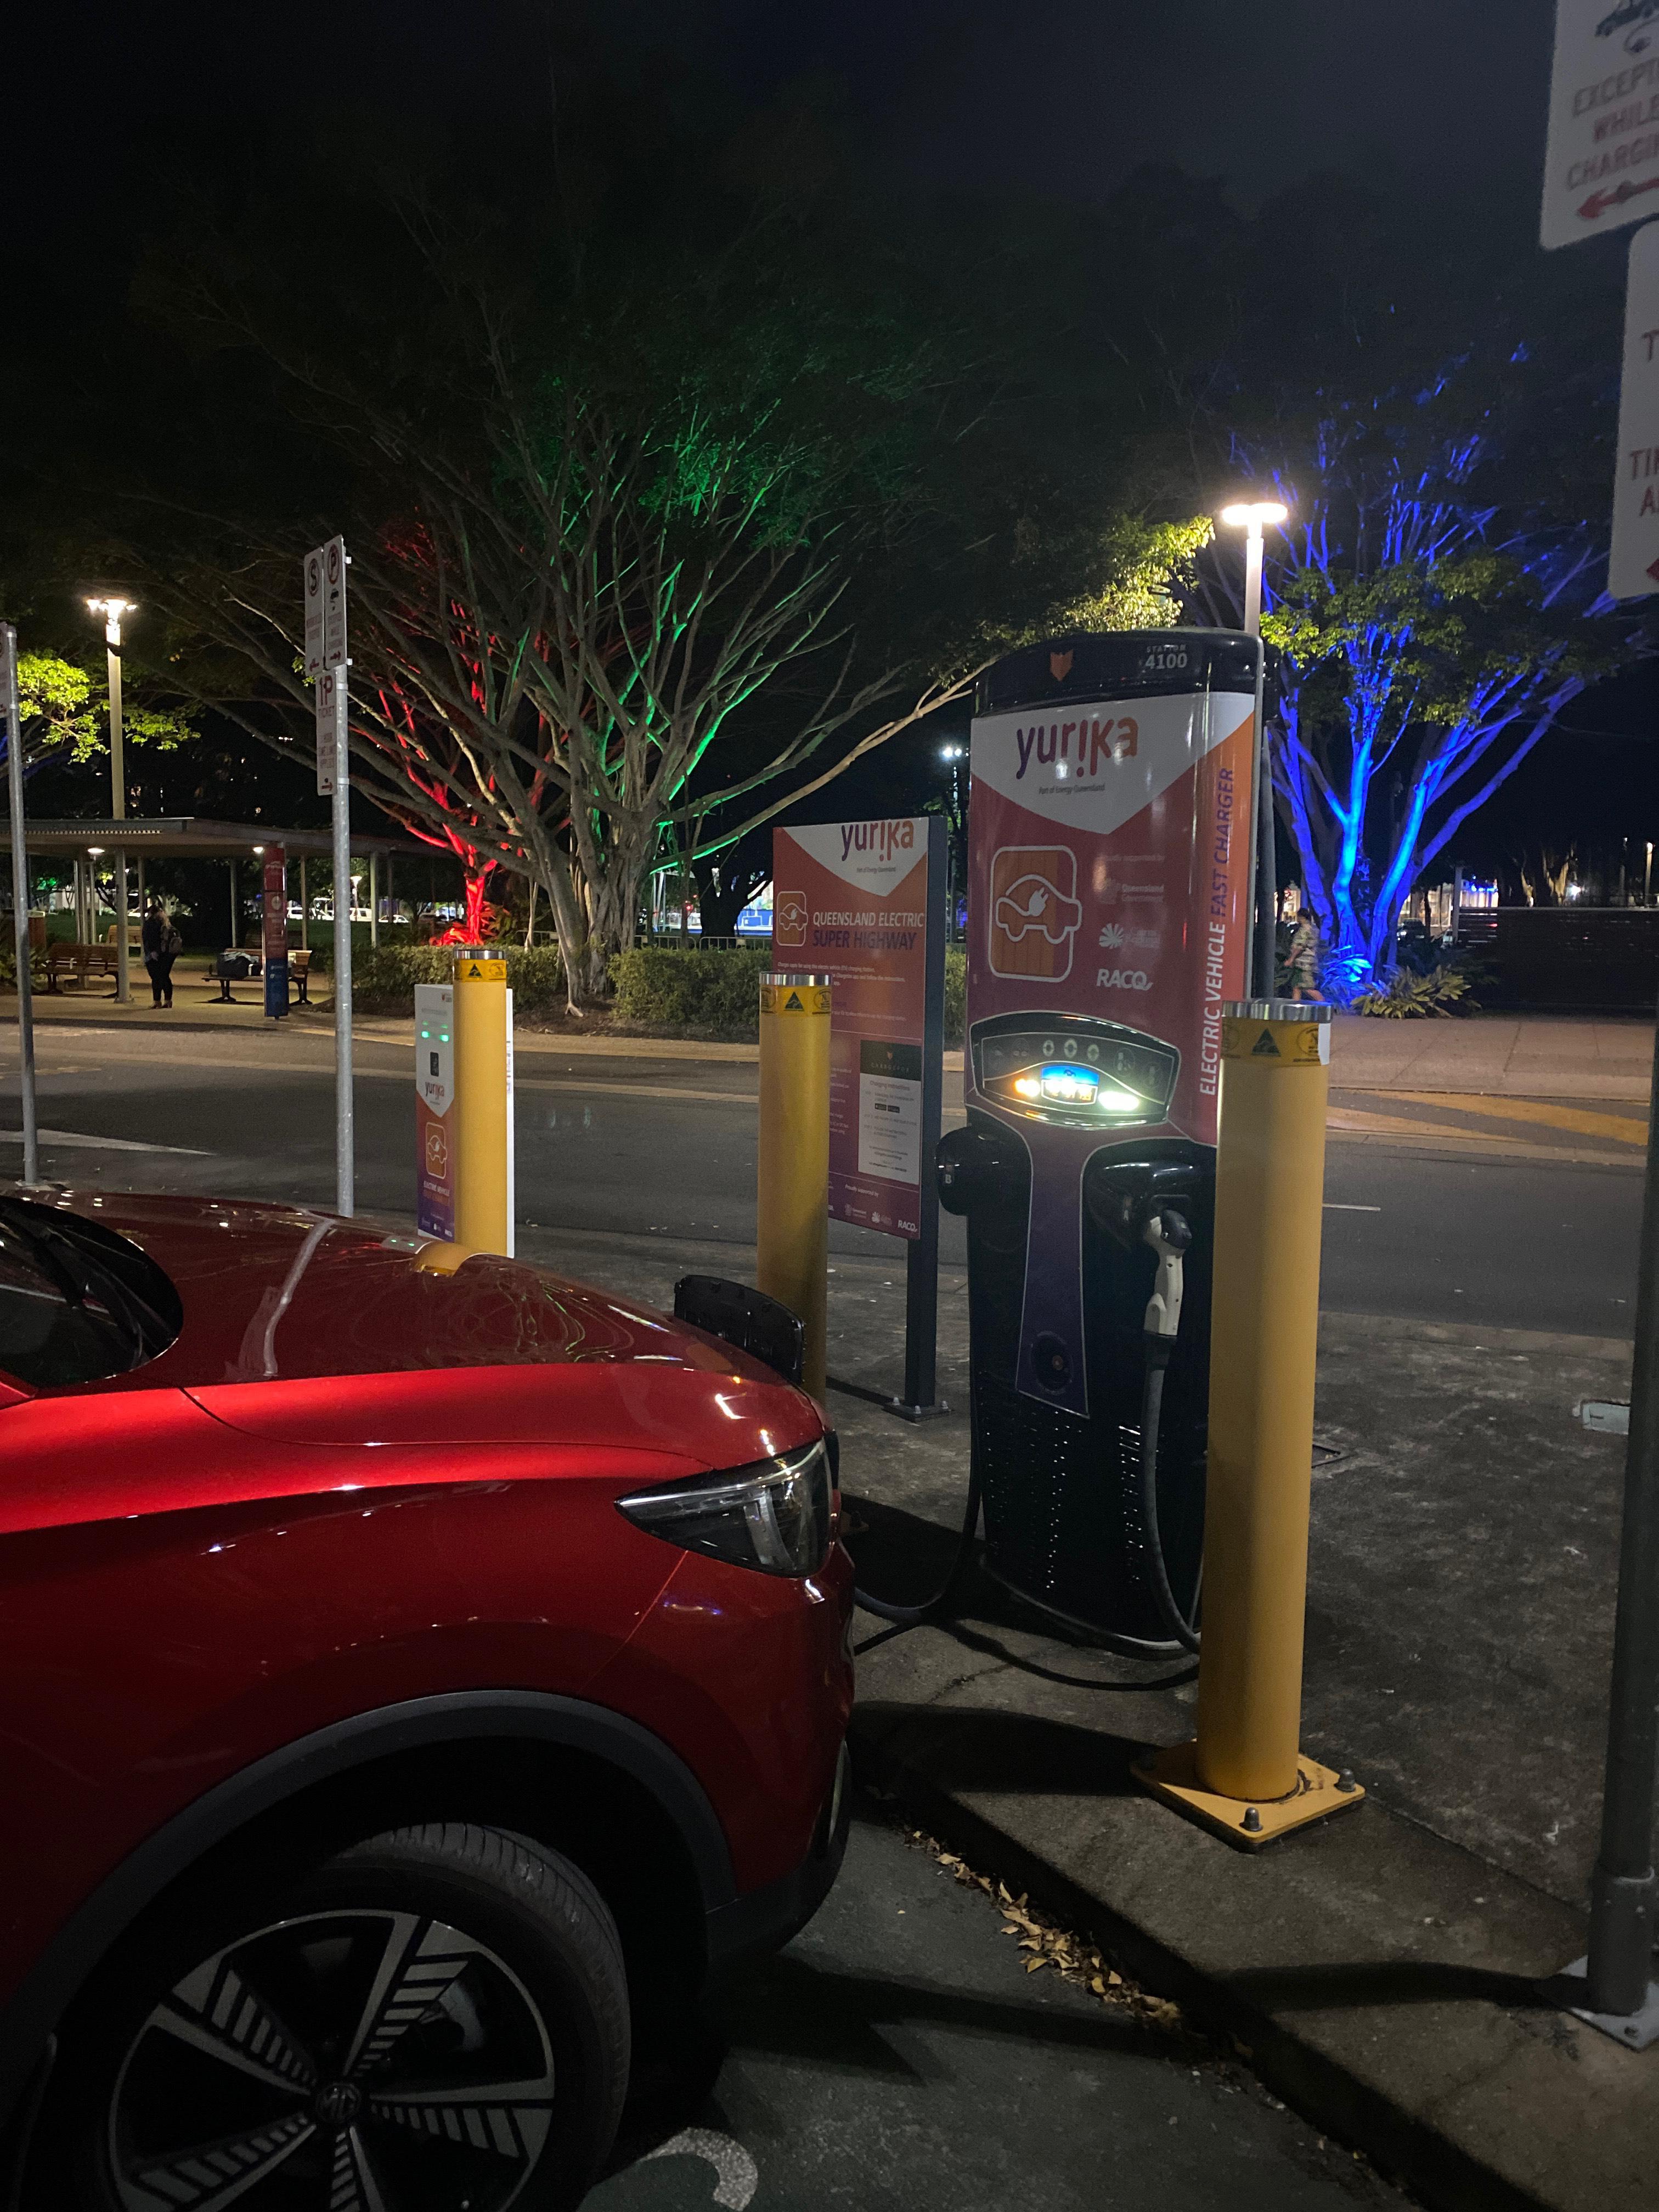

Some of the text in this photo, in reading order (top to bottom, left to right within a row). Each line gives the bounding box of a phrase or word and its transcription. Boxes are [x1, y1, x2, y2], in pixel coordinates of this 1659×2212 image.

[1573, 57, 1659, 116] EXCEPT
[1146, 653, 1187, 669] 4100
[319, 675, 333, 706] 1P
[1016, 717, 1139, 780] yurika
[1039, 787, 1048, 795] Part
[842, 820, 914, 861] yurika
[1211, 769, 1234, 917] FAST CHARGER
[812, 912, 924, 927] QUEENSLAND ELECTRIC
[812, 929, 917, 950] SUPER HIGHWAY
[1096, 969, 1153, 991] RACQ
[1199, 922, 1226, 1096] ELECTRIC VEHICLE
[945, 1173, 952, 1184] B
[898, 1220, 918, 1232] RACQ
